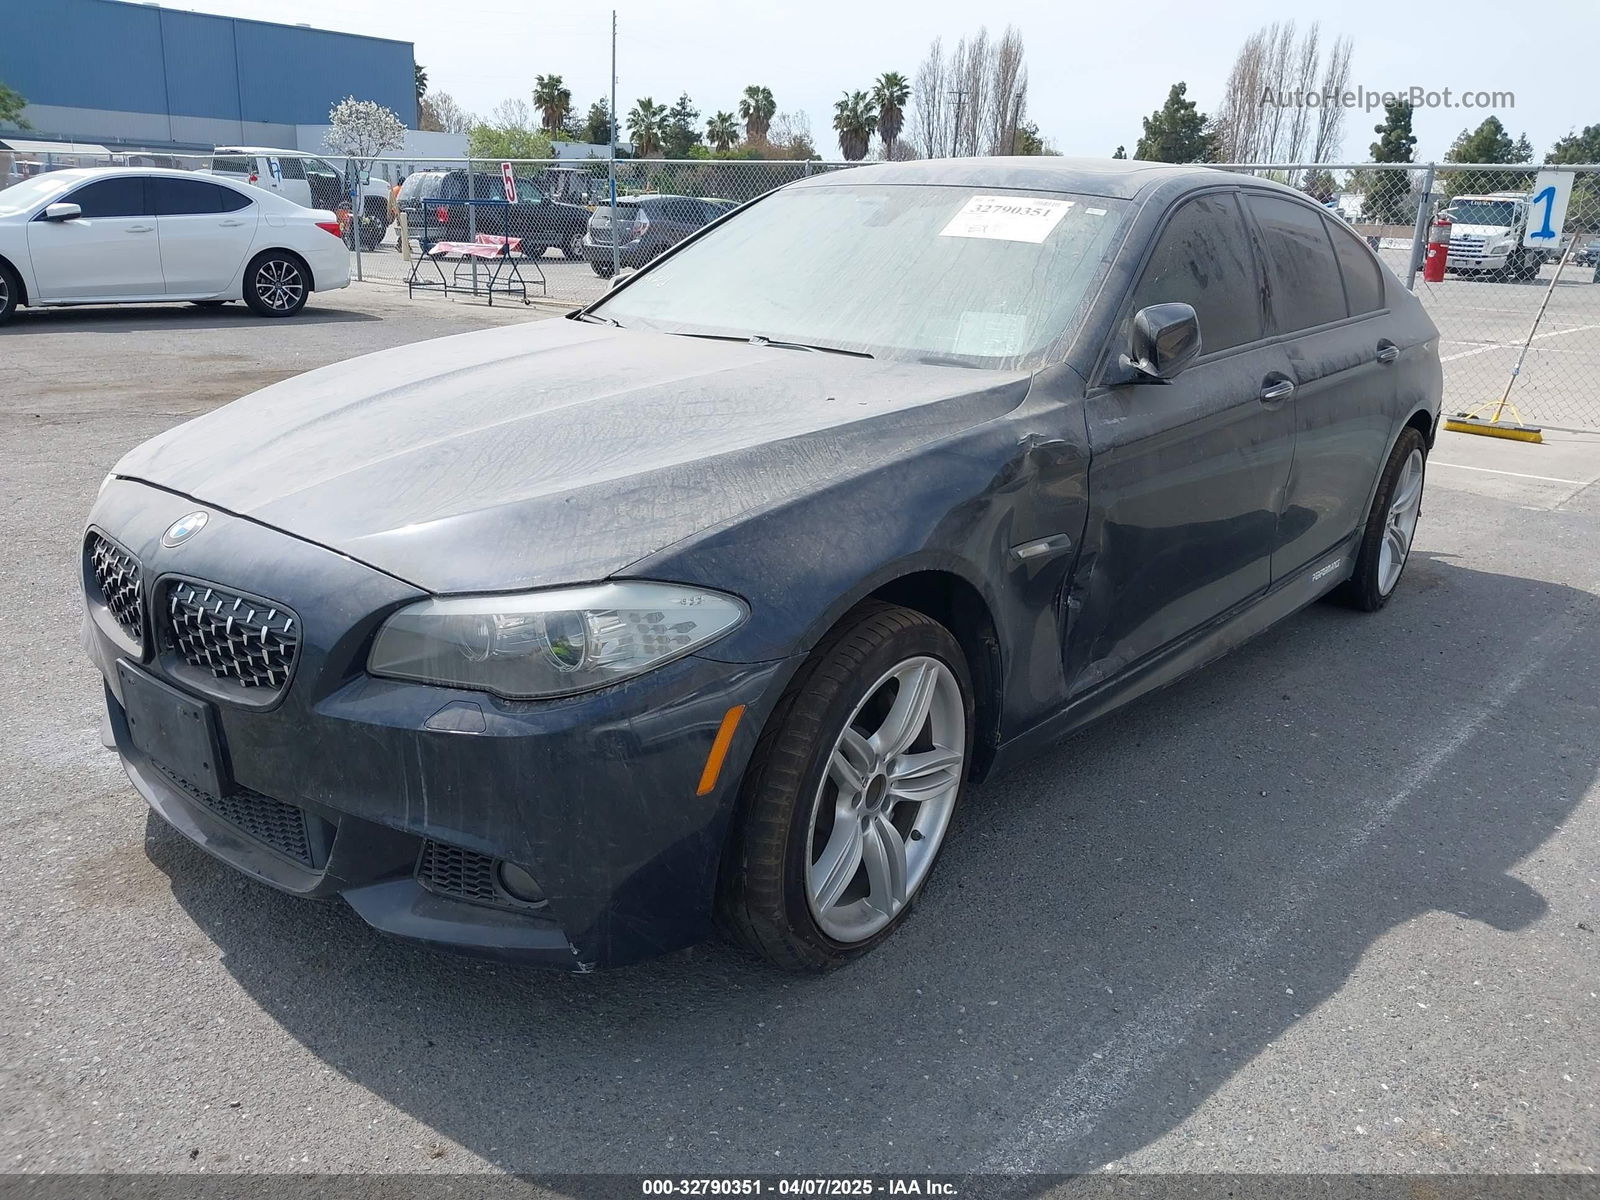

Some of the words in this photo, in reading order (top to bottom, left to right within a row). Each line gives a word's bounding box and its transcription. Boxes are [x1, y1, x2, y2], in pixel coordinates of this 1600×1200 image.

[503, 164, 515, 201] 5
[969, 204, 1052, 217] 32790351
[1530, 186, 1556, 239] 1
